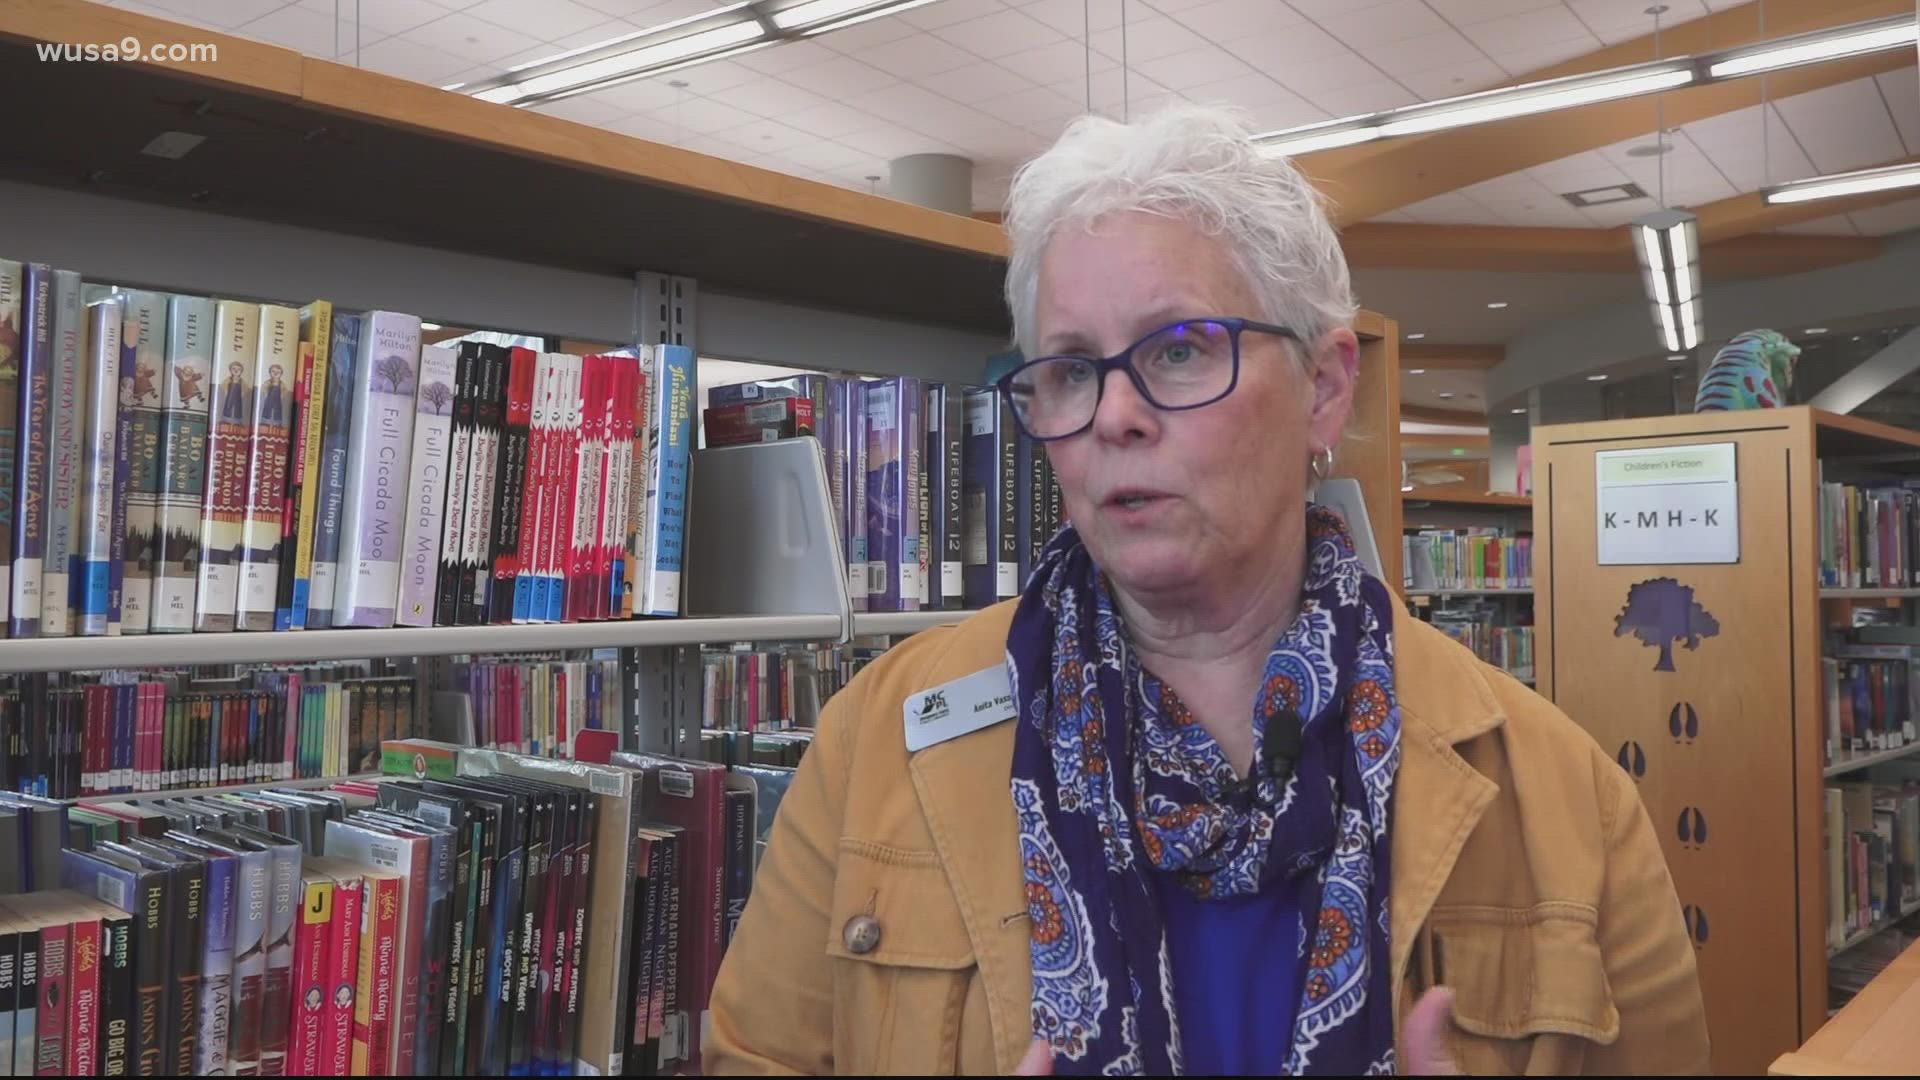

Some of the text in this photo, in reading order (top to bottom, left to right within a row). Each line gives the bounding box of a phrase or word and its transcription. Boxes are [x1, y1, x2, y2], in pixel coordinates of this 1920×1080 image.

[37, 281, 49, 326] Kirkpatrick
[138, 309, 149, 346] HILL
[185, 313, 198, 351] HILL
[233, 316, 245, 353] HILL
[272, 320, 285, 357] HILL
[376, 328, 416, 342] Marilyn
[380, 339, 411, 350] Hilton
[463, 358, 473, 399] Himmelman
[482, 360, 491, 400] Himmelman
[31, 398, 47, 428] Year
[668, 364, 685, 447] Hiranandani
[678, 387, 689, 419] Veera
[30, 431, 44, 448] of
[381, 407, 399, 441] Full
[143, 432, 156, 459] BO
[189, 436, 202, 462] BO
[28, 450, 44, 486] Miss
[54, 452, 70, 511] SISTER
[223, 442, 235, 505] IDITAROD
[234, 453, 247, 479] BO
[261, 443, 275, 506] IDITAROD
[273, 453, 287, 479] BO
[374, 444, 396, 512] Cicada
[581, 470, 590, 480] of
[610, 471, 619, 480] of
[1624, 459, 1703, 471] Children's Fiction
[324, 448, 346, 534] Found Things
[414, 427, 442, 586] Full Cicada Moon
[452, 474, 464, 505] Bunny's
[471, 475, 482, 506] Bunny's
[920, 488, 928, 521] LION
[949, 441, 960, 550] LIFEBOAT 12
[1004, 443, 1015, 550] LIFEBOAT 12
[1034, 460, 1042, 533] LIFEBOAT
[26, 491, 44, 538] Agnes
[450, 507, 460, 529] Best
[470, 507, 479, 529] Best
[447, 531, 457, 553] Move
[467, 531, 477, 553] Move
[523, 528, 531, 540] the
[974, 700, 992, 713] Anita
[736, 804, 745, 851] HOFFMAN
[438, 844, 448, 881] HOBBS
[663, 847, 673, 877] ALICE
[188, 879, 201, 920] HOBBS
[248, 867, 264, 921] HOBBS
[275, 861, 291, 913] HOBBS
[312, 892, 324, 913] J
[380, 890, 395, 920] Hobbs
[147, 887, 161, 929] HOBBS
[344, 898, 354, 919] MARY
[574, 908, 585, 946] ZOMBIES
[659, 880, 670, 936] HOFFMAN
[343, 921, 352, 938] ANN
[638, 851, 659, 1029] ALICE HOFFMAN NIGHTBIRD
[0, 954, 13, 989] HOBBS
[22, 952, 36, 986] HOBBS
[43, 939, 65, 978] HOBBS
[341, 939, 351, 979] HOBERMAN
[379, 936, 392, 975] Minnie
[447, 921, 463, 1023] VAMPIRES AND VEGGIES
[503, 949, 512, 979] GHOST
[516, 912, 534, 1012] VAMPIRES AND VEGGIES
[553, 931, 565, 992] WITCH'S BREW
[108, 926, 128, 1076] HOBBS GO BIG OR
[177, 974, 200, 1031] JASON'S
[373, 978, 390, 1021] McClary
[501, 980, 509, 1002] TRAP
[567, 968, 579, 1013] MEATBALLS
[78, 989, 93, 1034] Minnie
[139, 985, 162, 1044] JASON'S
[211, 974, 231, 1046] MAGGIE
[401, 976, 418, 1057] SHEEP
